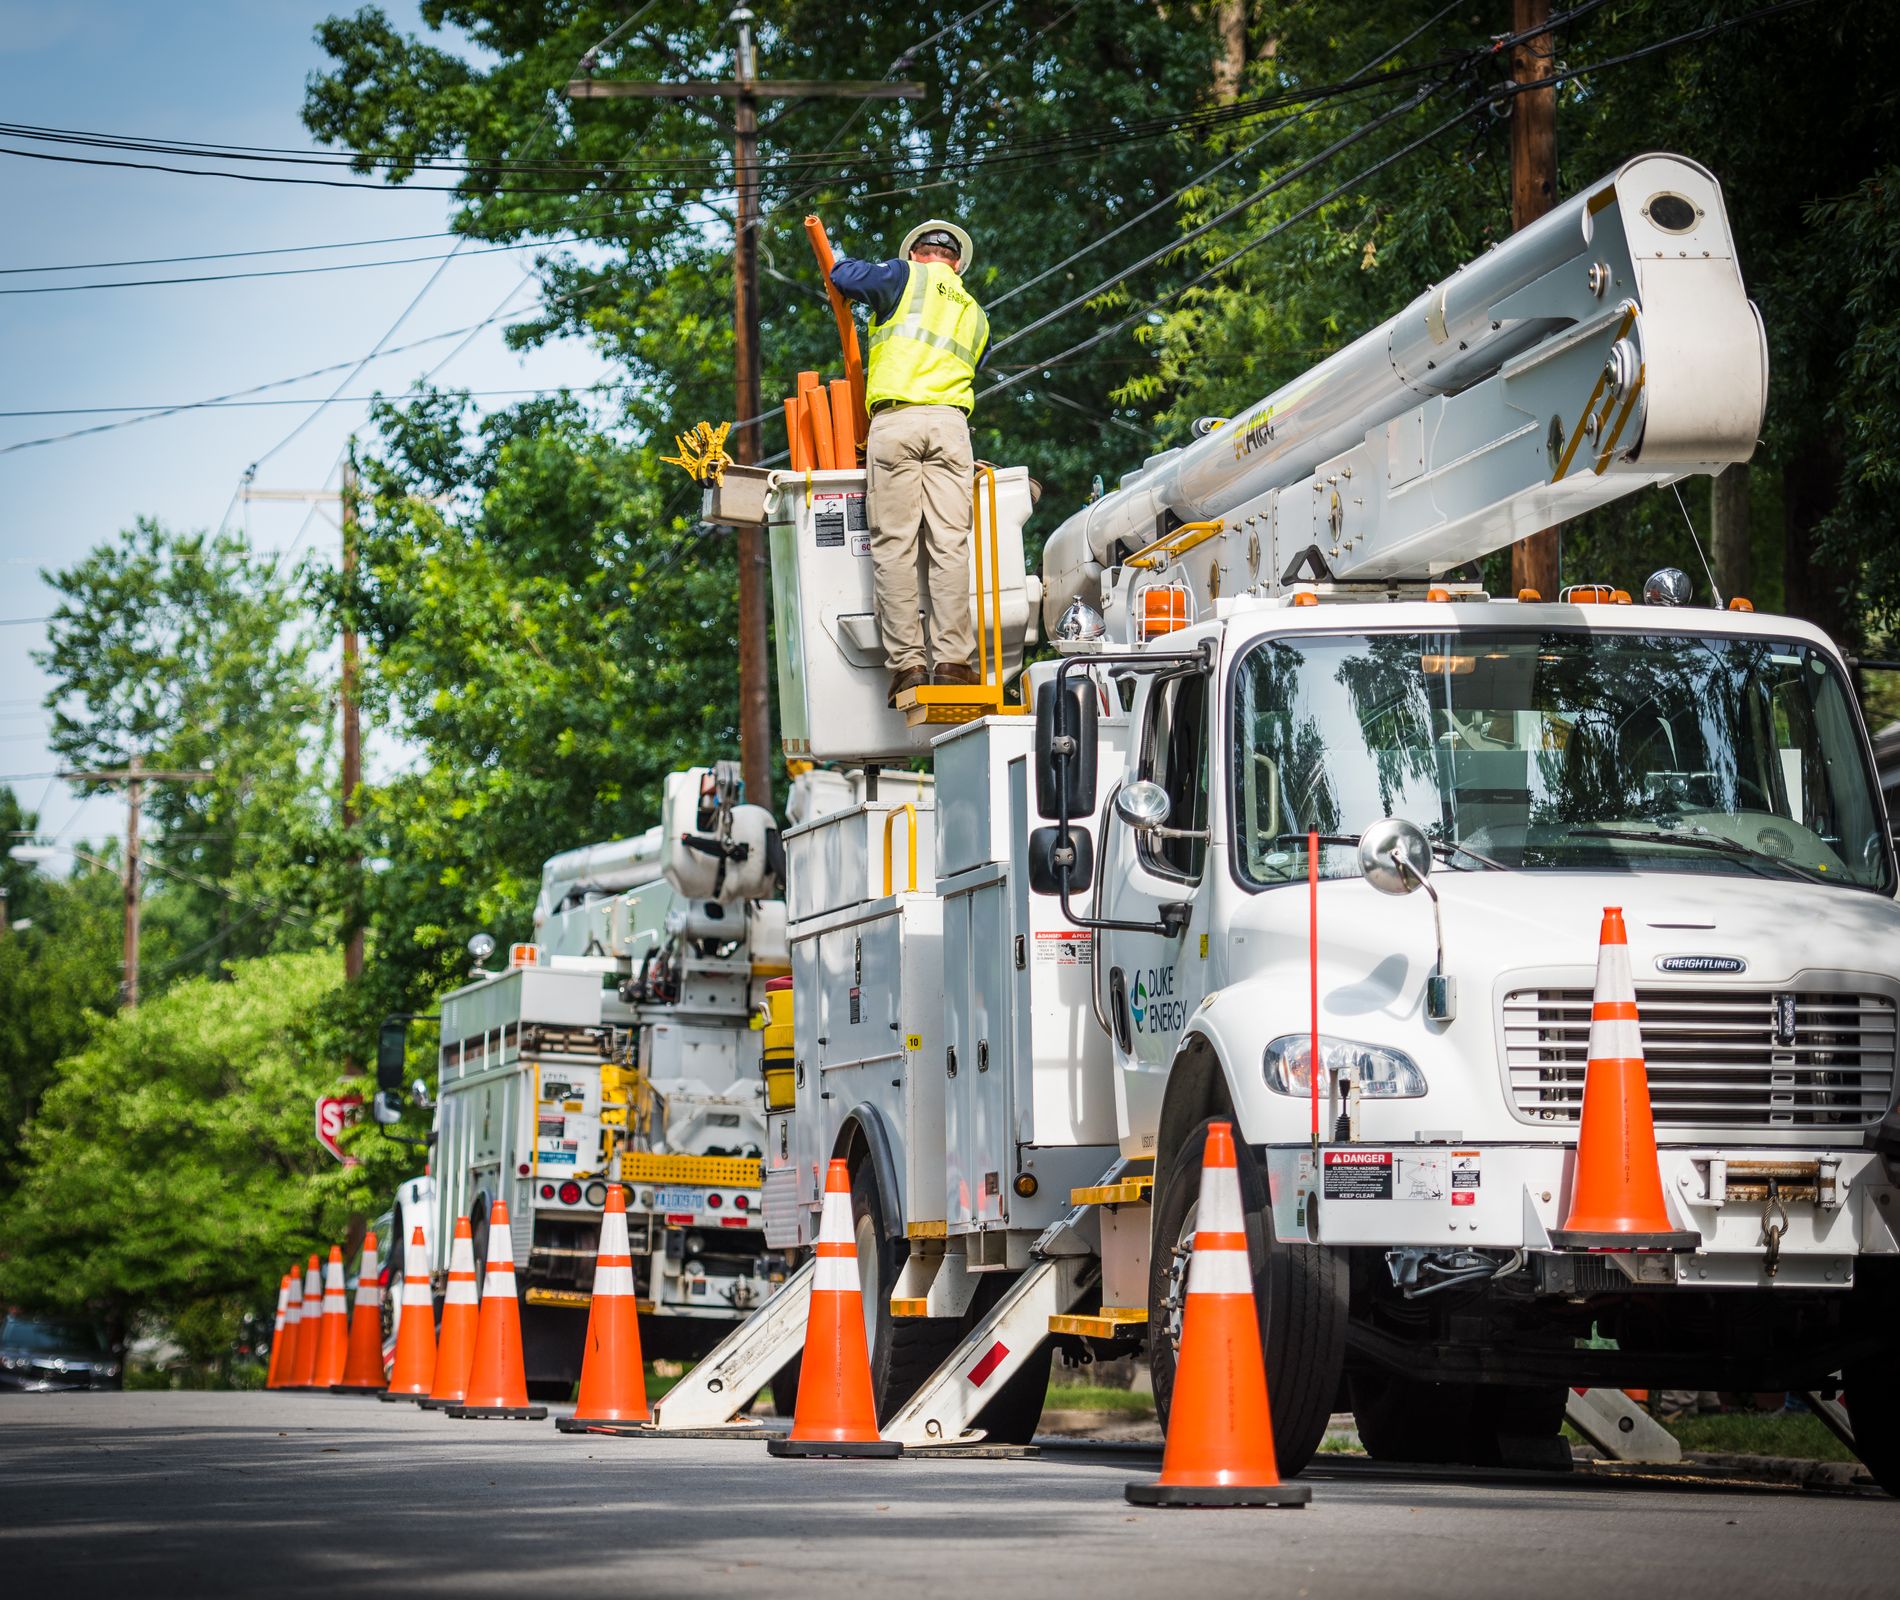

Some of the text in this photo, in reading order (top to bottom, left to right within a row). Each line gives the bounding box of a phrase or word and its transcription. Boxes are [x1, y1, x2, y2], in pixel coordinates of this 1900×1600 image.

[861, 543, 871, 551] 60
[1665, 958, 1738, 969] FREIGHTLINER
[1148, 966, 1174, 998] DUKE
[1150, 1000, 1188, 1034] ENERGY
[909, 1038, 919, 1047] 10
[322, 1102, 360, 1136] ST
[1343, 1154, 1385, 1163] DANGER
